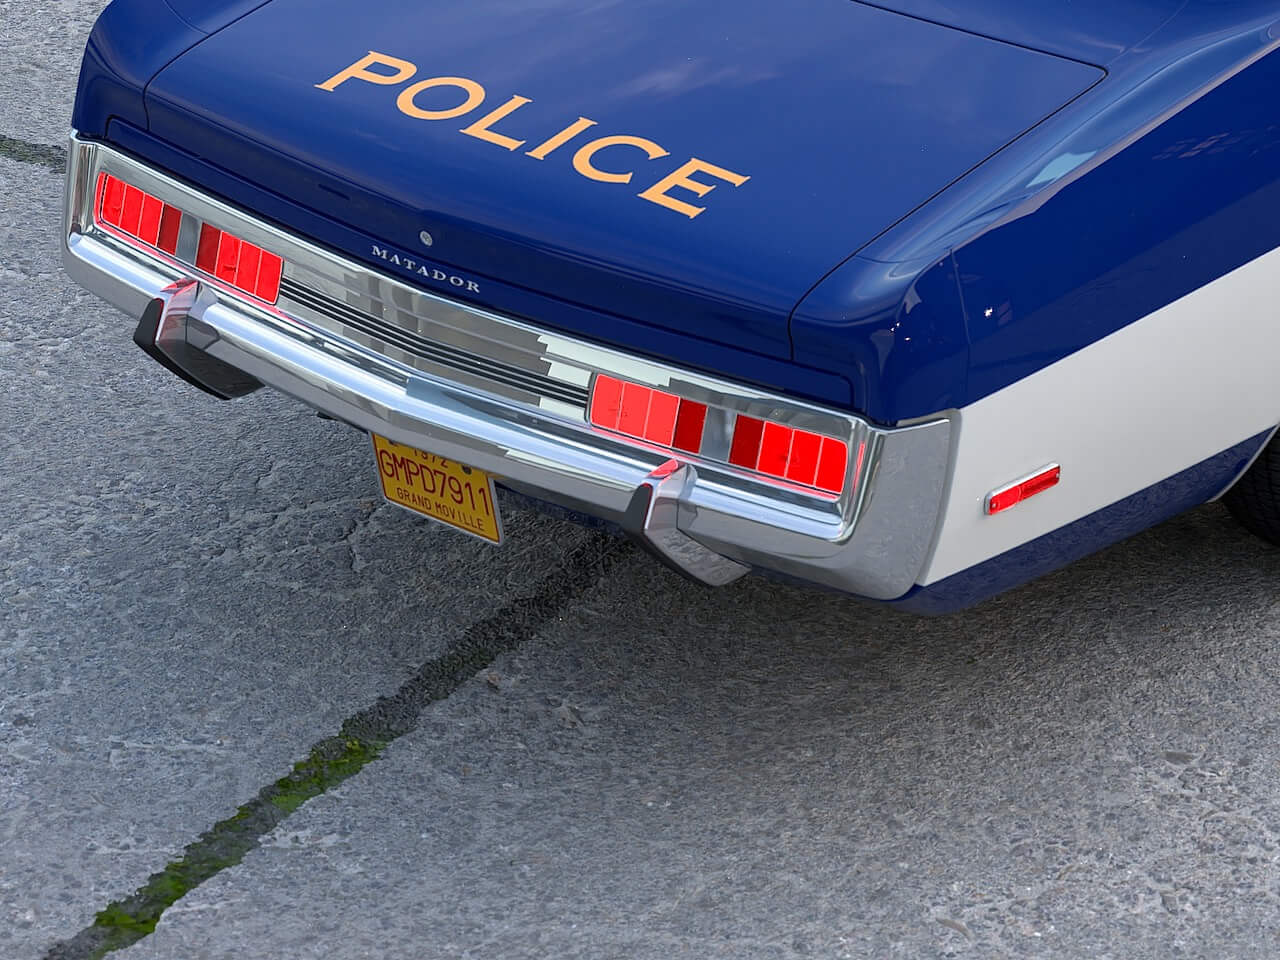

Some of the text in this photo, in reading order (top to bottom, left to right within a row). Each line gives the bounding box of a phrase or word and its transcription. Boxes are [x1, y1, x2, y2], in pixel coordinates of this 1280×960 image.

[313, 50, 752, 219] POLICE
[370, 244, 481, 294] MATADOR
[379, 448, 490, 517] GMPD7911
[396, 487, 485, 531] GRAND MOVILLE
